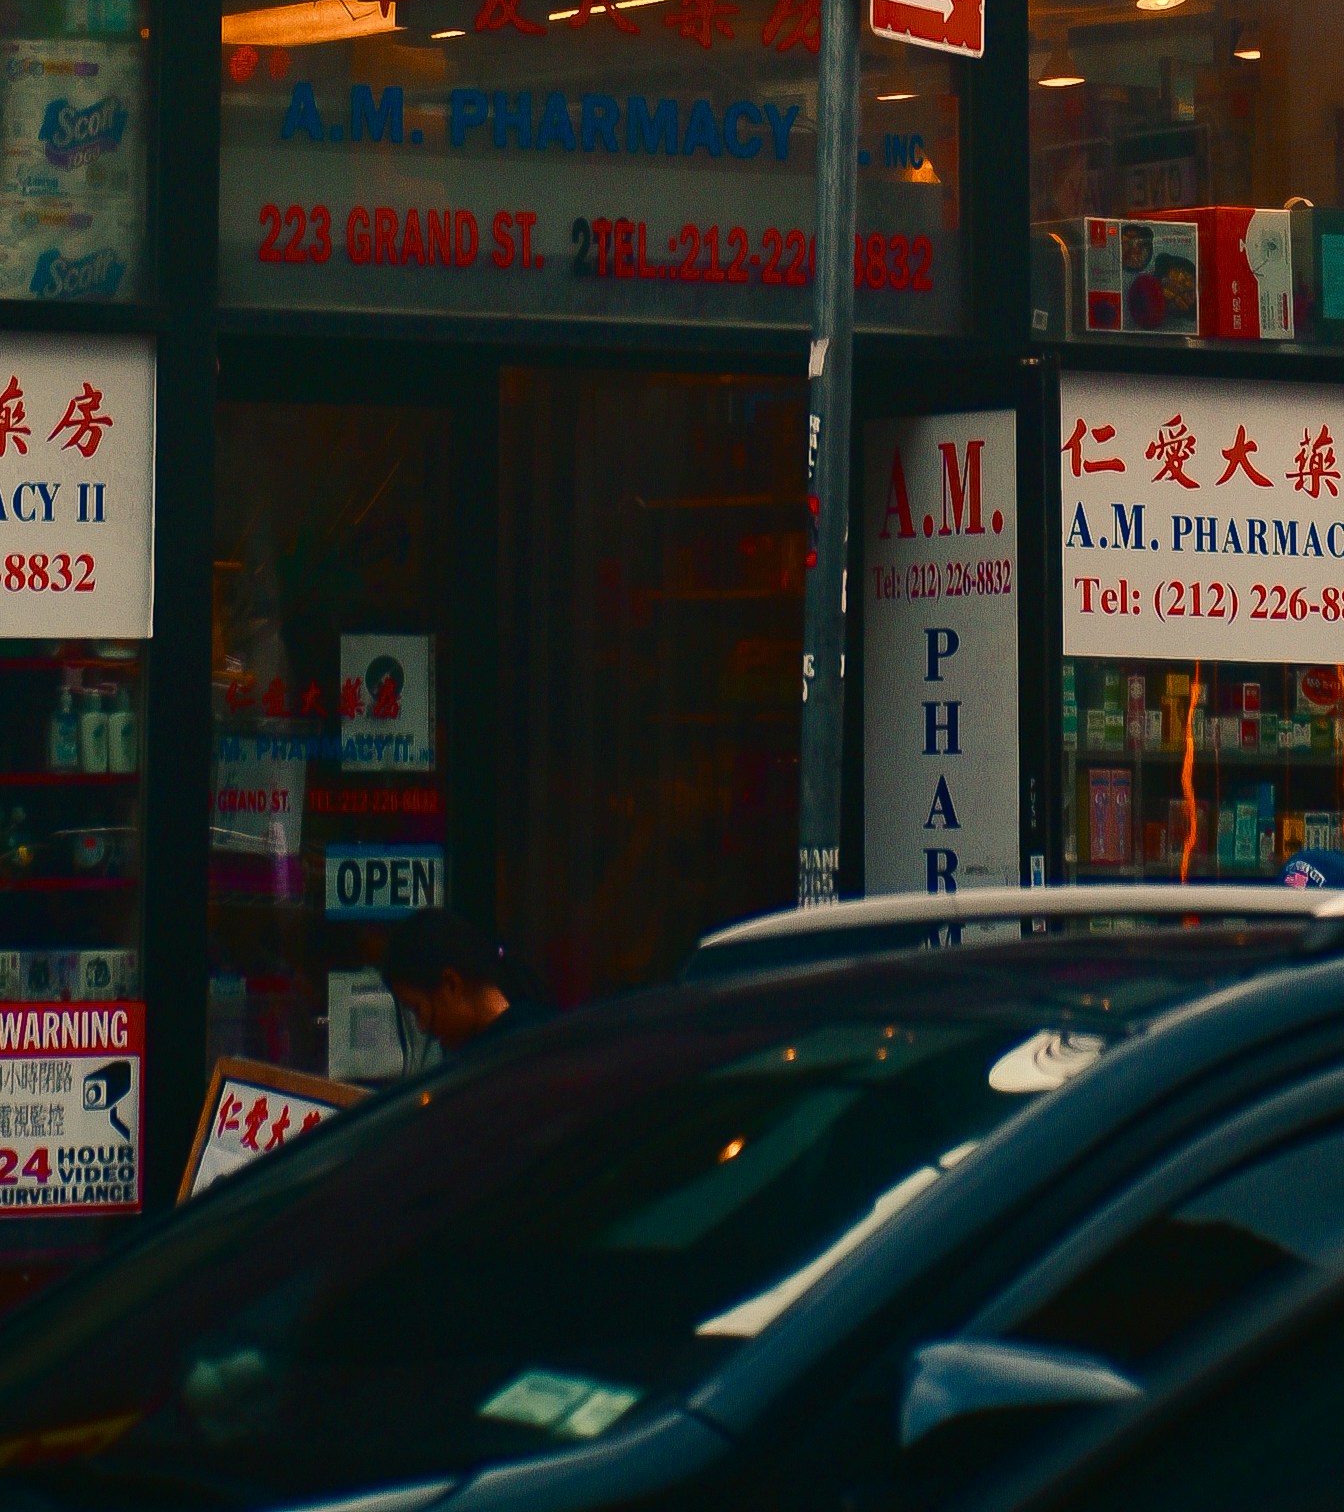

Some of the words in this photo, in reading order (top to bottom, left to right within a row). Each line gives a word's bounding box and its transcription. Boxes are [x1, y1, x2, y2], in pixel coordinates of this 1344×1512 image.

[281, 81, 424, 145] A.M.
[450, 87, 801, 161] PHARMACY
[259, 204, 332, 264] 223
[346, 205, 480, 268] GRAND
[492, 211, 544, 269] ST.
[77, 483, 107, 524] II
[879, 439, 1005, 539] A.M.
[1066, 501, 1160, 551] A.M.
[873, 565, 902, 601] Tel:
[904, 563, 943, 603] (212)
[945, 560, 1012, 598] 226-8832
[1074, 577, 1141, 616] Tel:
[1154, 580, 1240, 625] (212)
[255, 734, 388, 762] PHARMACY
[217, 789, 267, 814] GRAND
[335, 859, 436, 908] OPEN
[58, 1145, 134, 1166] HOUR
[58, 1165, 135, 1185] VIDEO
